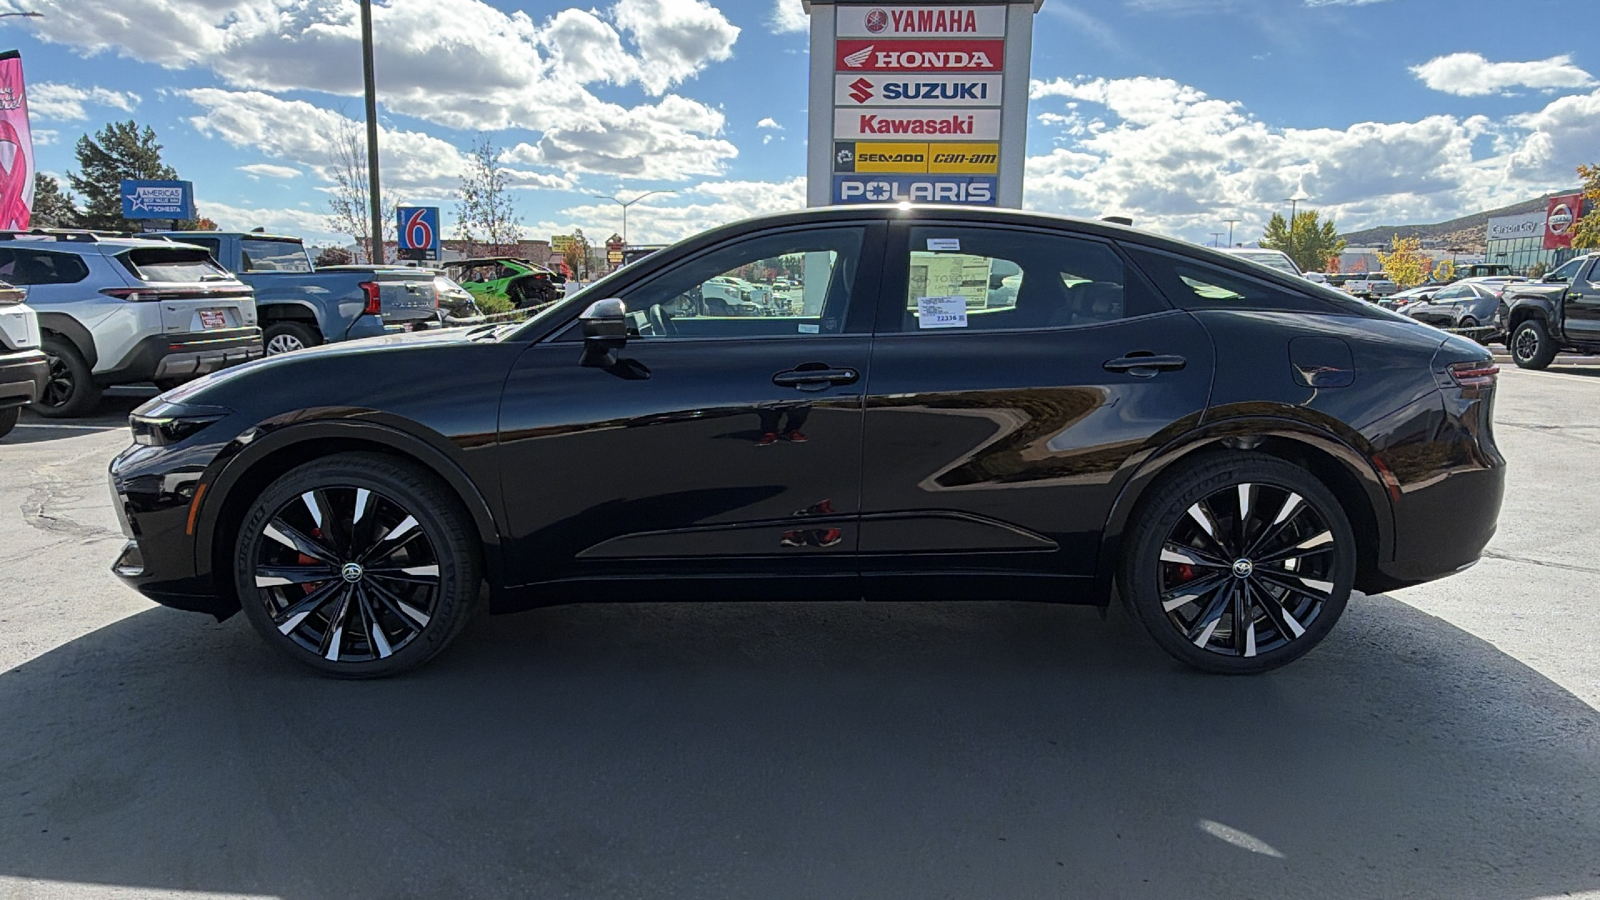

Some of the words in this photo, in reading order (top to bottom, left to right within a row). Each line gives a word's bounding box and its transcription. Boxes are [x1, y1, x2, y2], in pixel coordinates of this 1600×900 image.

[891, 10, 977, 32] YAMAHA
[875, 51, 994, 68] HONDA
[882, 82, 988, 99] SUZUKI
[859, 115, 974, 134] Kawasaki
[841, 181, 991, 202] POLARIS
[405, 208, 433, 249] 6
[1491, 224, 1520, 234] Carson
[1520, 220, 1537, 233] City
[934, 274, 976, 283] TOYOTA
